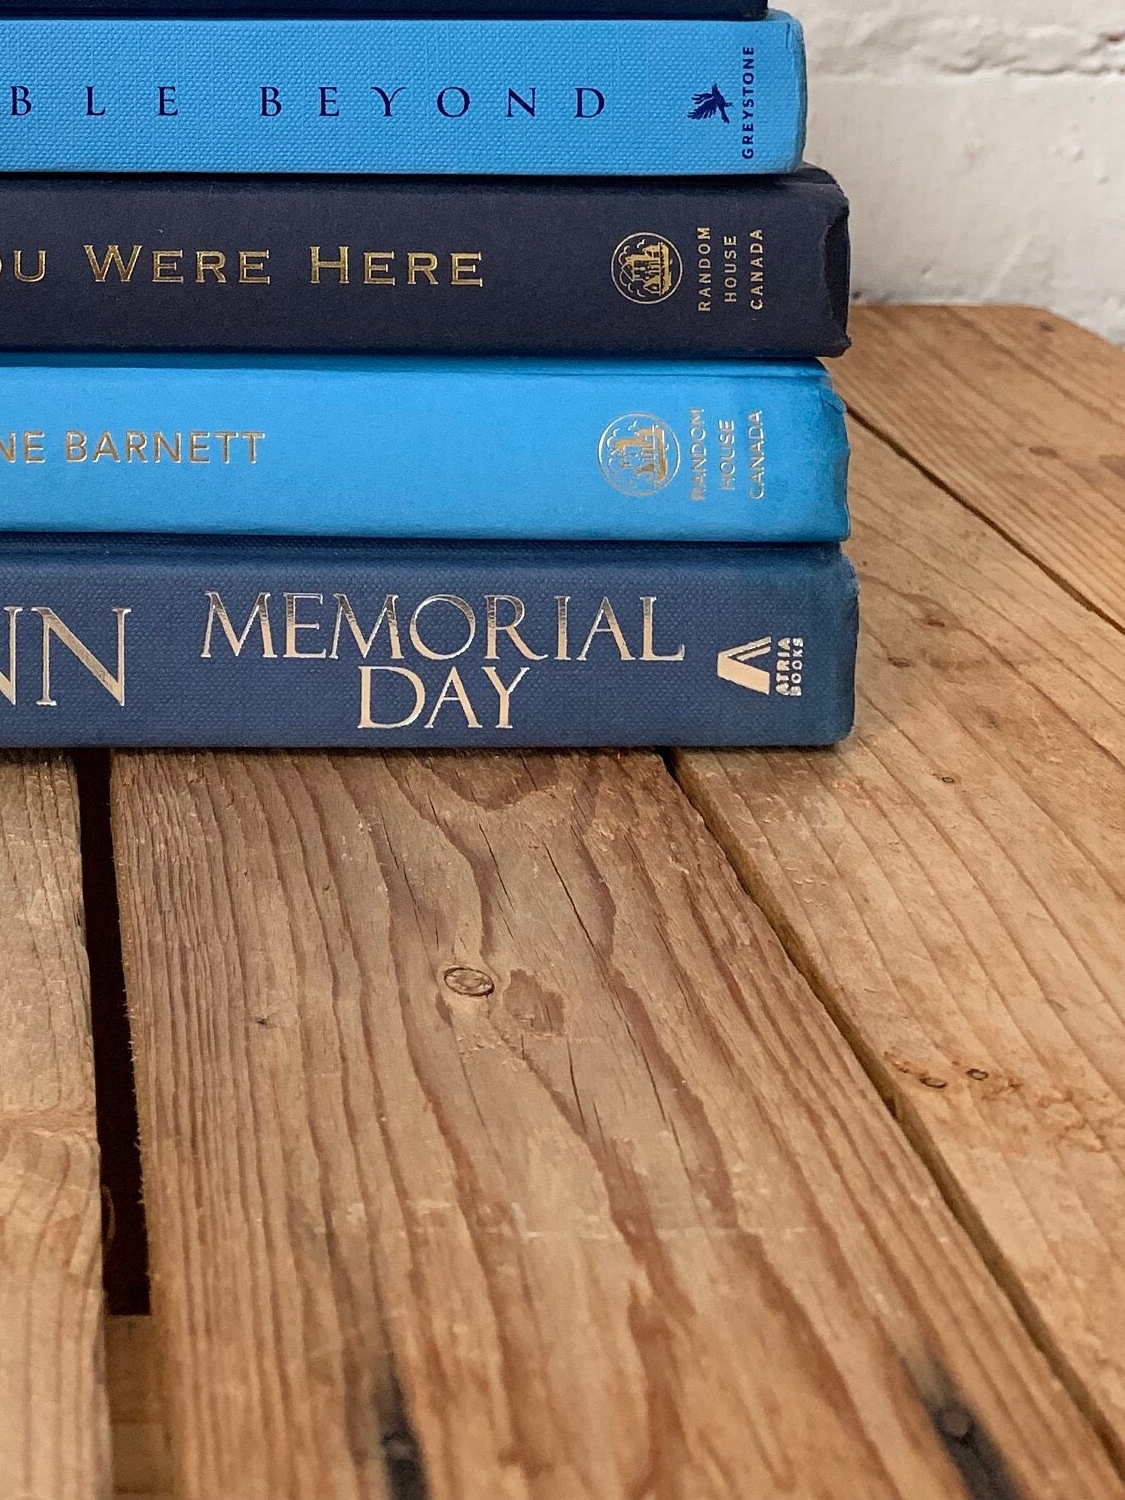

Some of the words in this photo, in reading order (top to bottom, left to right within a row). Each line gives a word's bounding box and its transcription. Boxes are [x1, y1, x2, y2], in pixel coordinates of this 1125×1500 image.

[259, 85, 606, 119] BEYOND
[741, 45, 756, 160] GREYSTONE
[697, 227, 711, 312] RANDOM
[724, 235, 738, 304] HOUSE
[750, 229, 764, 311] CANADA
[65, 430, 266, 464] BARNETT
[690, 408, 706, 501] RANDOM
[718, 419, 735, 491] HOUSE
[748, 410, 765, 500] CANADA
[200, 591, 686, 661] MEMORIAL
[357, 665, 531, 730] DAY
[775, 637, 791, 696] ATRIA
[789, 637, 804, 697] BOOKS
